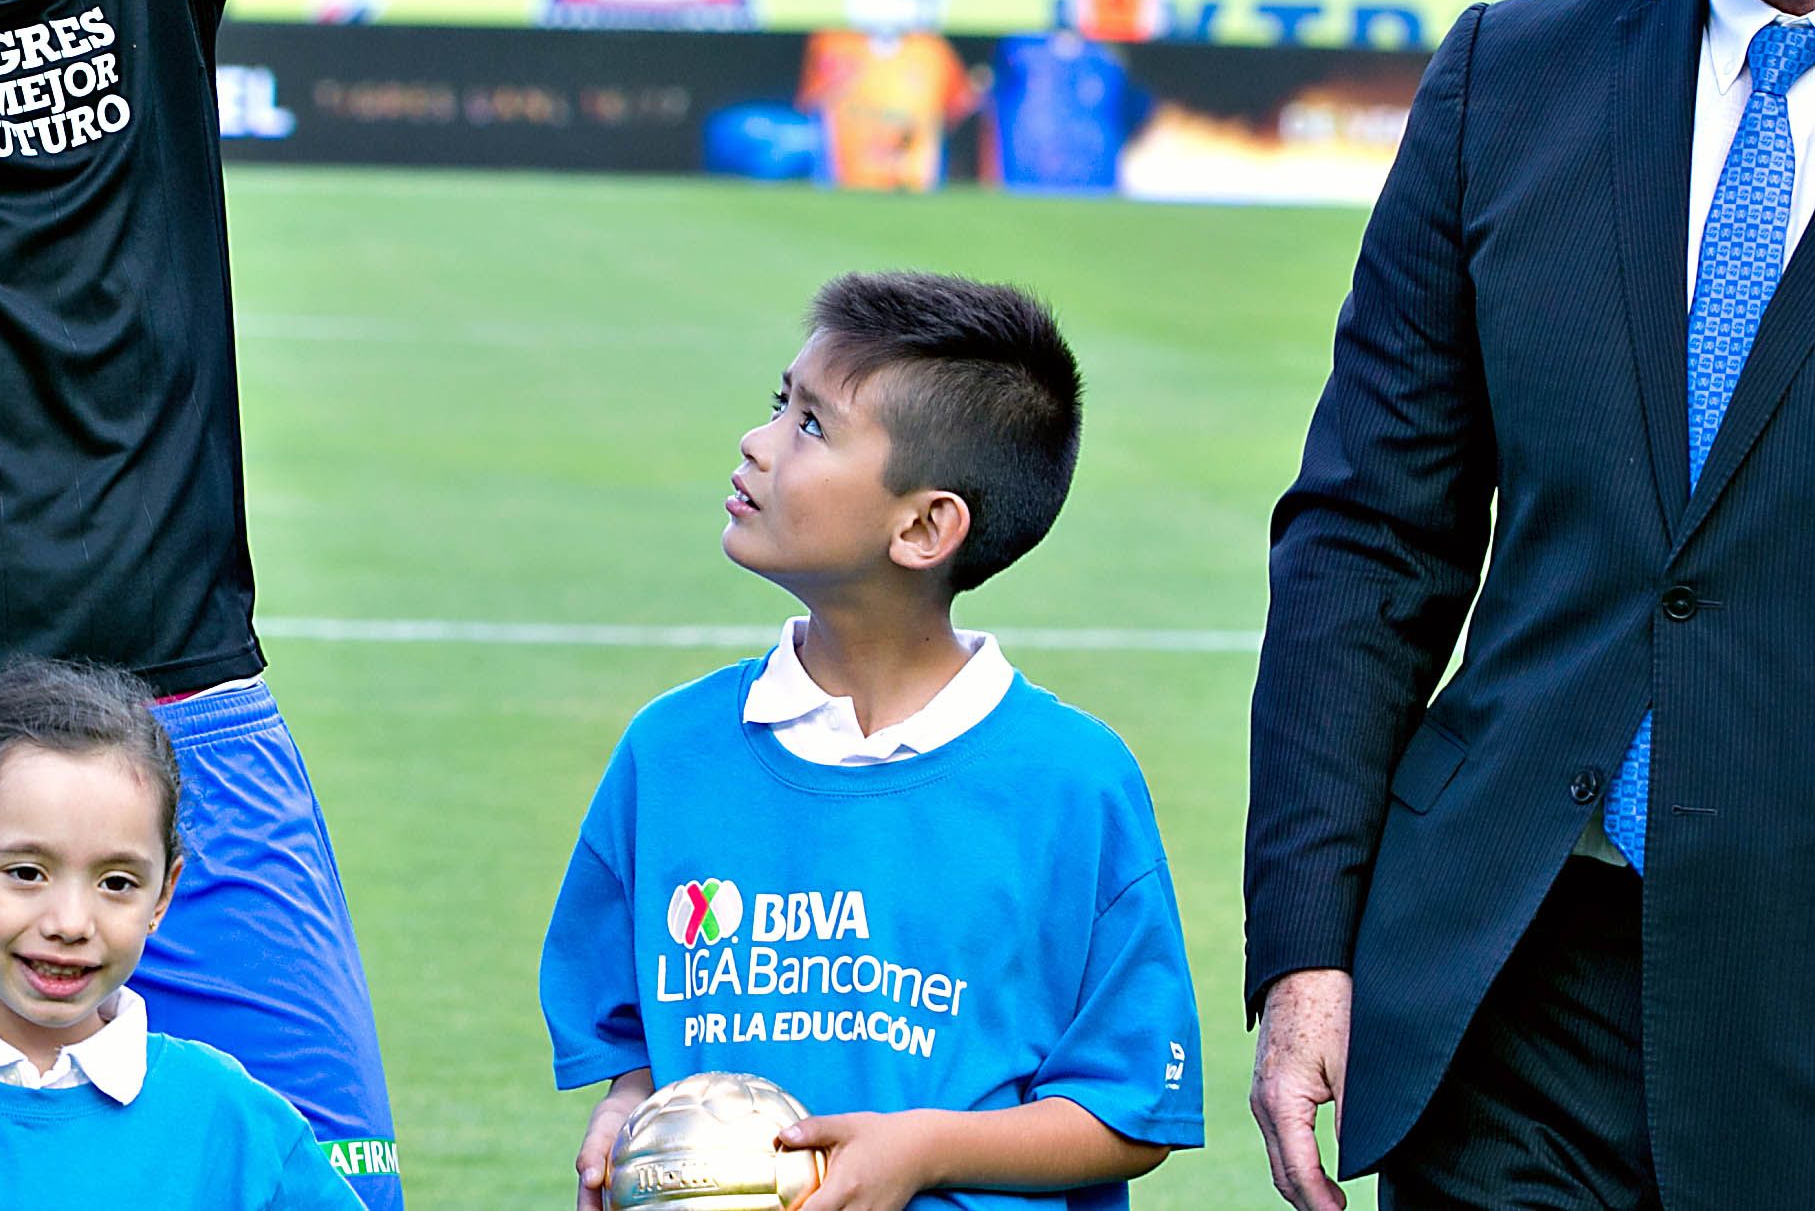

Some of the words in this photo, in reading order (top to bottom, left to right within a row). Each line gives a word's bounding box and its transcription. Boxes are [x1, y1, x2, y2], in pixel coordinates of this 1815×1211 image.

[751, 891, 870, 942] BBVA
[657, 947, 742, 1002] LIGA
[747, 946, 968, 1016] Bancomer
[732, 1012, 767, 1043] LA
